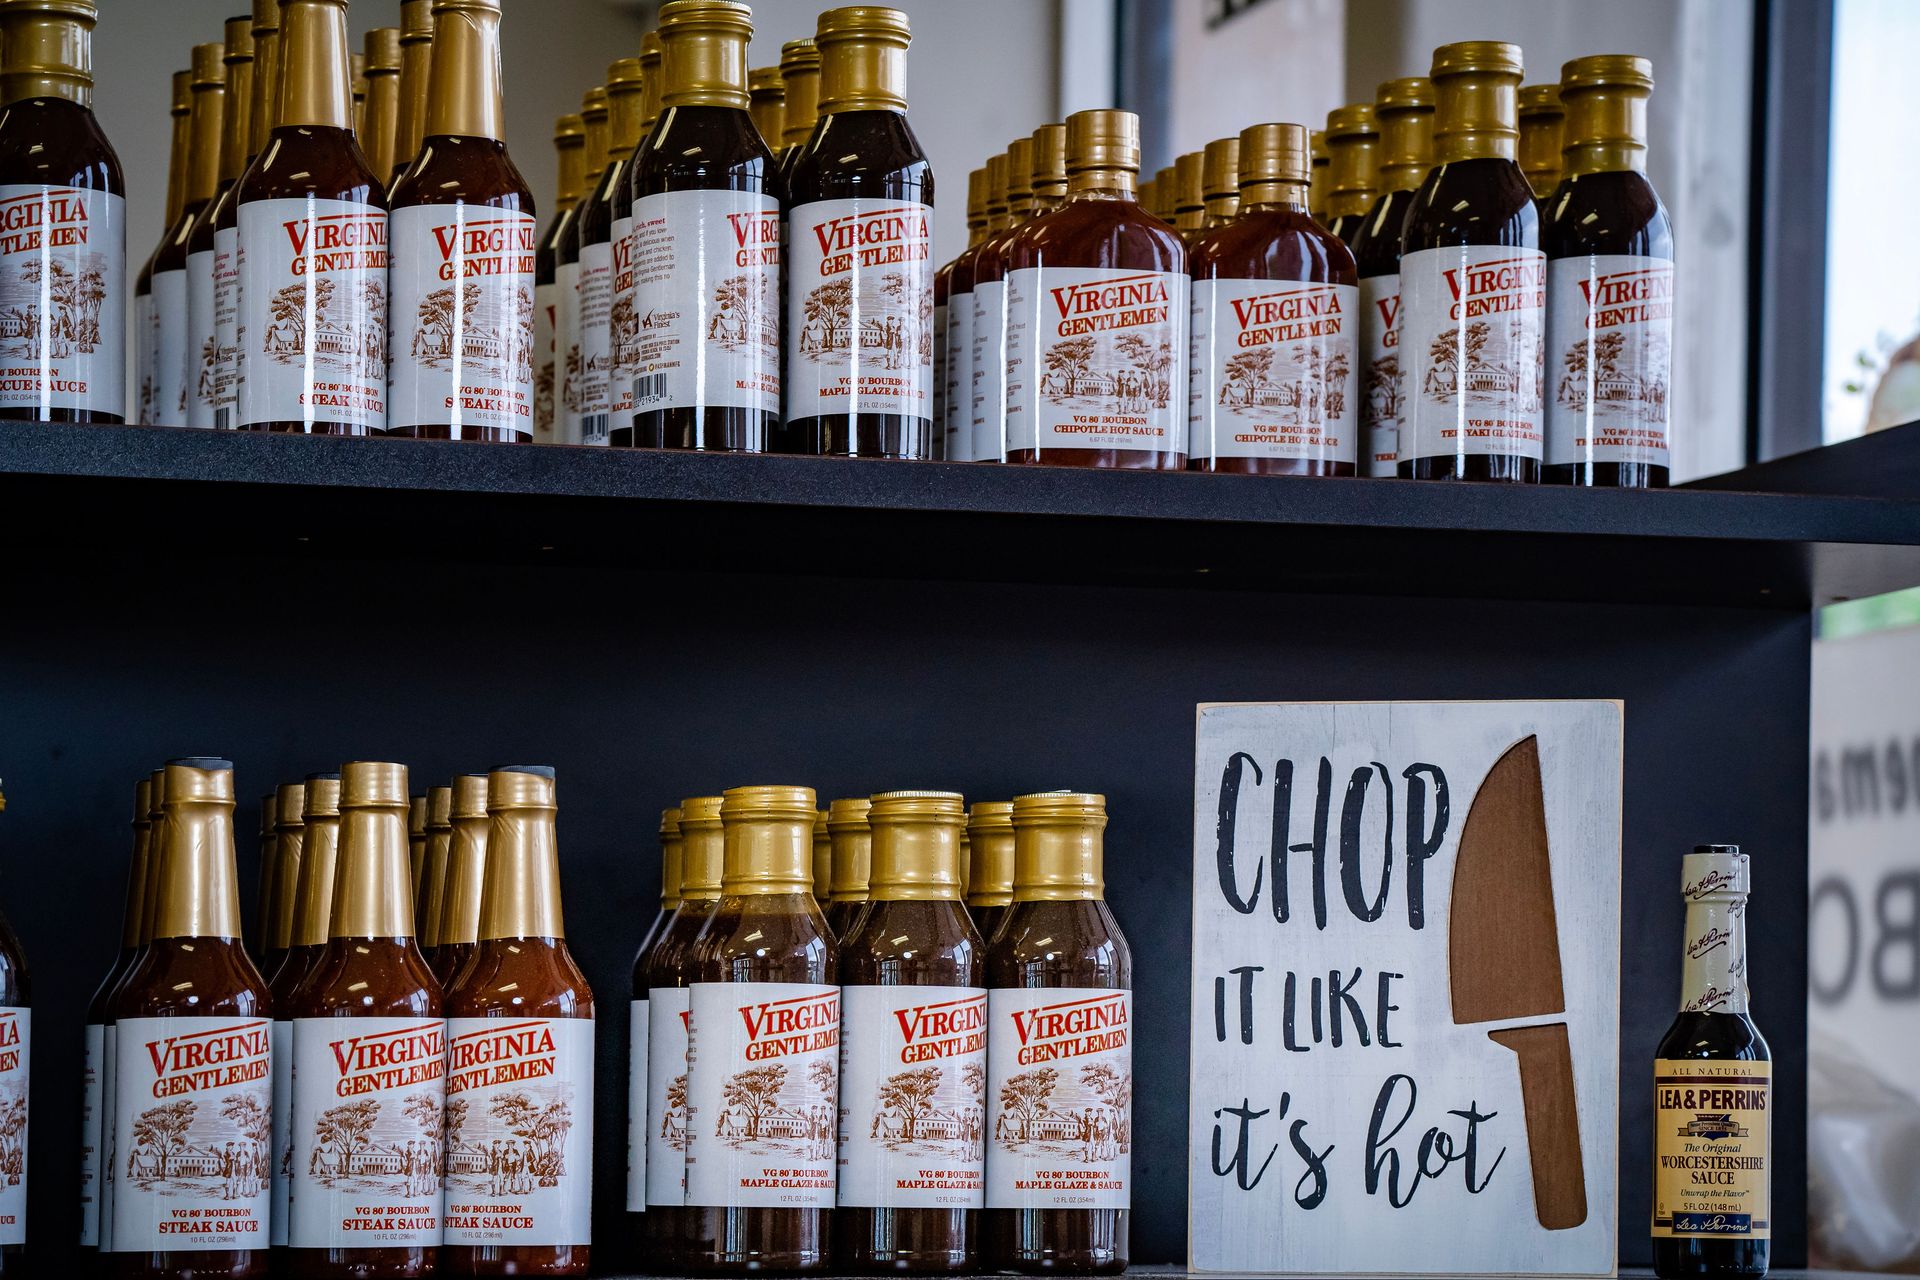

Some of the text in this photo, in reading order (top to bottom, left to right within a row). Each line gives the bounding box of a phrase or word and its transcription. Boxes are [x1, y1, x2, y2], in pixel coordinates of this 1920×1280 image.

[283, 219, 387, 256] VIRGINI
[291, 250, 387, 276] GENTLEME
[438, 256, 535, 281] GENTLEME
[1051, 280, 1168, 319] VIRGINIA
[1231, 293, 1341, 330] VIRGINIA
[653, 321, 671, 329] Finest
[1058, 305, 1168, 337] GENTLEMEN
[1238, 318, 1341, 348] GENTLEMEN
[8, 368, 59, 377] BOURN
[313, 383, 327, 391] VG
[868, 378, 912, 386] BOURBON
[858, 387, 891, 396] GLAZE
[892, 388, 899, 396] &
[352, 397, 384, 414] SAUCE
[1073, 415, 1147, 425] VG BOURBON
[1468, 419, 1482, 427] VG
[1054, 424, 1164, 437] CHIPOTLE HOT SAUCE
[1441, 428, 1490, 437] TEYAKI
[1603, 428, 1616, 436] VG
[1235, 434, 1286, 443] CHIPOTLE
[1576, 438, 1625, 446] TEIYAKI
[1217, 751, 1449, 930] CHOP
[1215, 966, 1404, 1052] IT LIKE
[738, 999, 839, 1041] VIRGINI
[893, 1003, 986, 1045] VIRGINI
[1011, 1000, 1127, 1045] VIRGINIA
[746, 1028, 839, 1061] GENTLEME
[1017, 1029, 1127, 1065] GENTLEMEN
[145, 1028, 270, 1077] VIRGINIA
[329, 1029, 446, 1076] VIRGINIA
[152, 1058, 270, 1098] GENTLEMEN
[337, 1058, 446, 1097] GENTLEMEN
[447, 1056, 556, 1096] GENTLEMEN
[1698, 1068, 1752, 1076] NATURAL
[1660, 1089, 1766, 1110] LEA & PERRINS
[1211, 1074, 1506, 1210] it's hot
[1684, 1143, 1742, 1155] The Original
[1661, 1156, 1763, 1169] WORCESTERSHIRE
[763, 1169, 777, 1177] VG
[919, 1170, 932, 1178] VG
[1065, 1171, 1110, 1179] BOURBON
[1691, 1172, 1735, 1185] SAUCE
[740, 1179, 819, 1188] MAPLE GLAZE &
[896, 1180, 972, 1189] MAPLE GLAZE &
[1015, 1181, 1052, 1189] MAPLE
[1054, 1181, 1088, 1189] GLAZE
[1090, 1181, 1097, 1189] &
[1680, 1189, 1710, 1198] Unwrap
[1710, 1189, 1722, 1197] the
[172, 1208, 251, 1218] VG BOURBON
[355, 1206, 430, 1215] VG BOURBON
[450, 1205, 522, 1213] VG BOURBON
[1698, 1203, 1709, 1211] OZ
[159, 1221, 258, 1233] STEAK SAUCE
[342, 1218, 436, 1230] STEAK SAUCE
[444, 1216, 534, 1229] STEAK SAUCE
